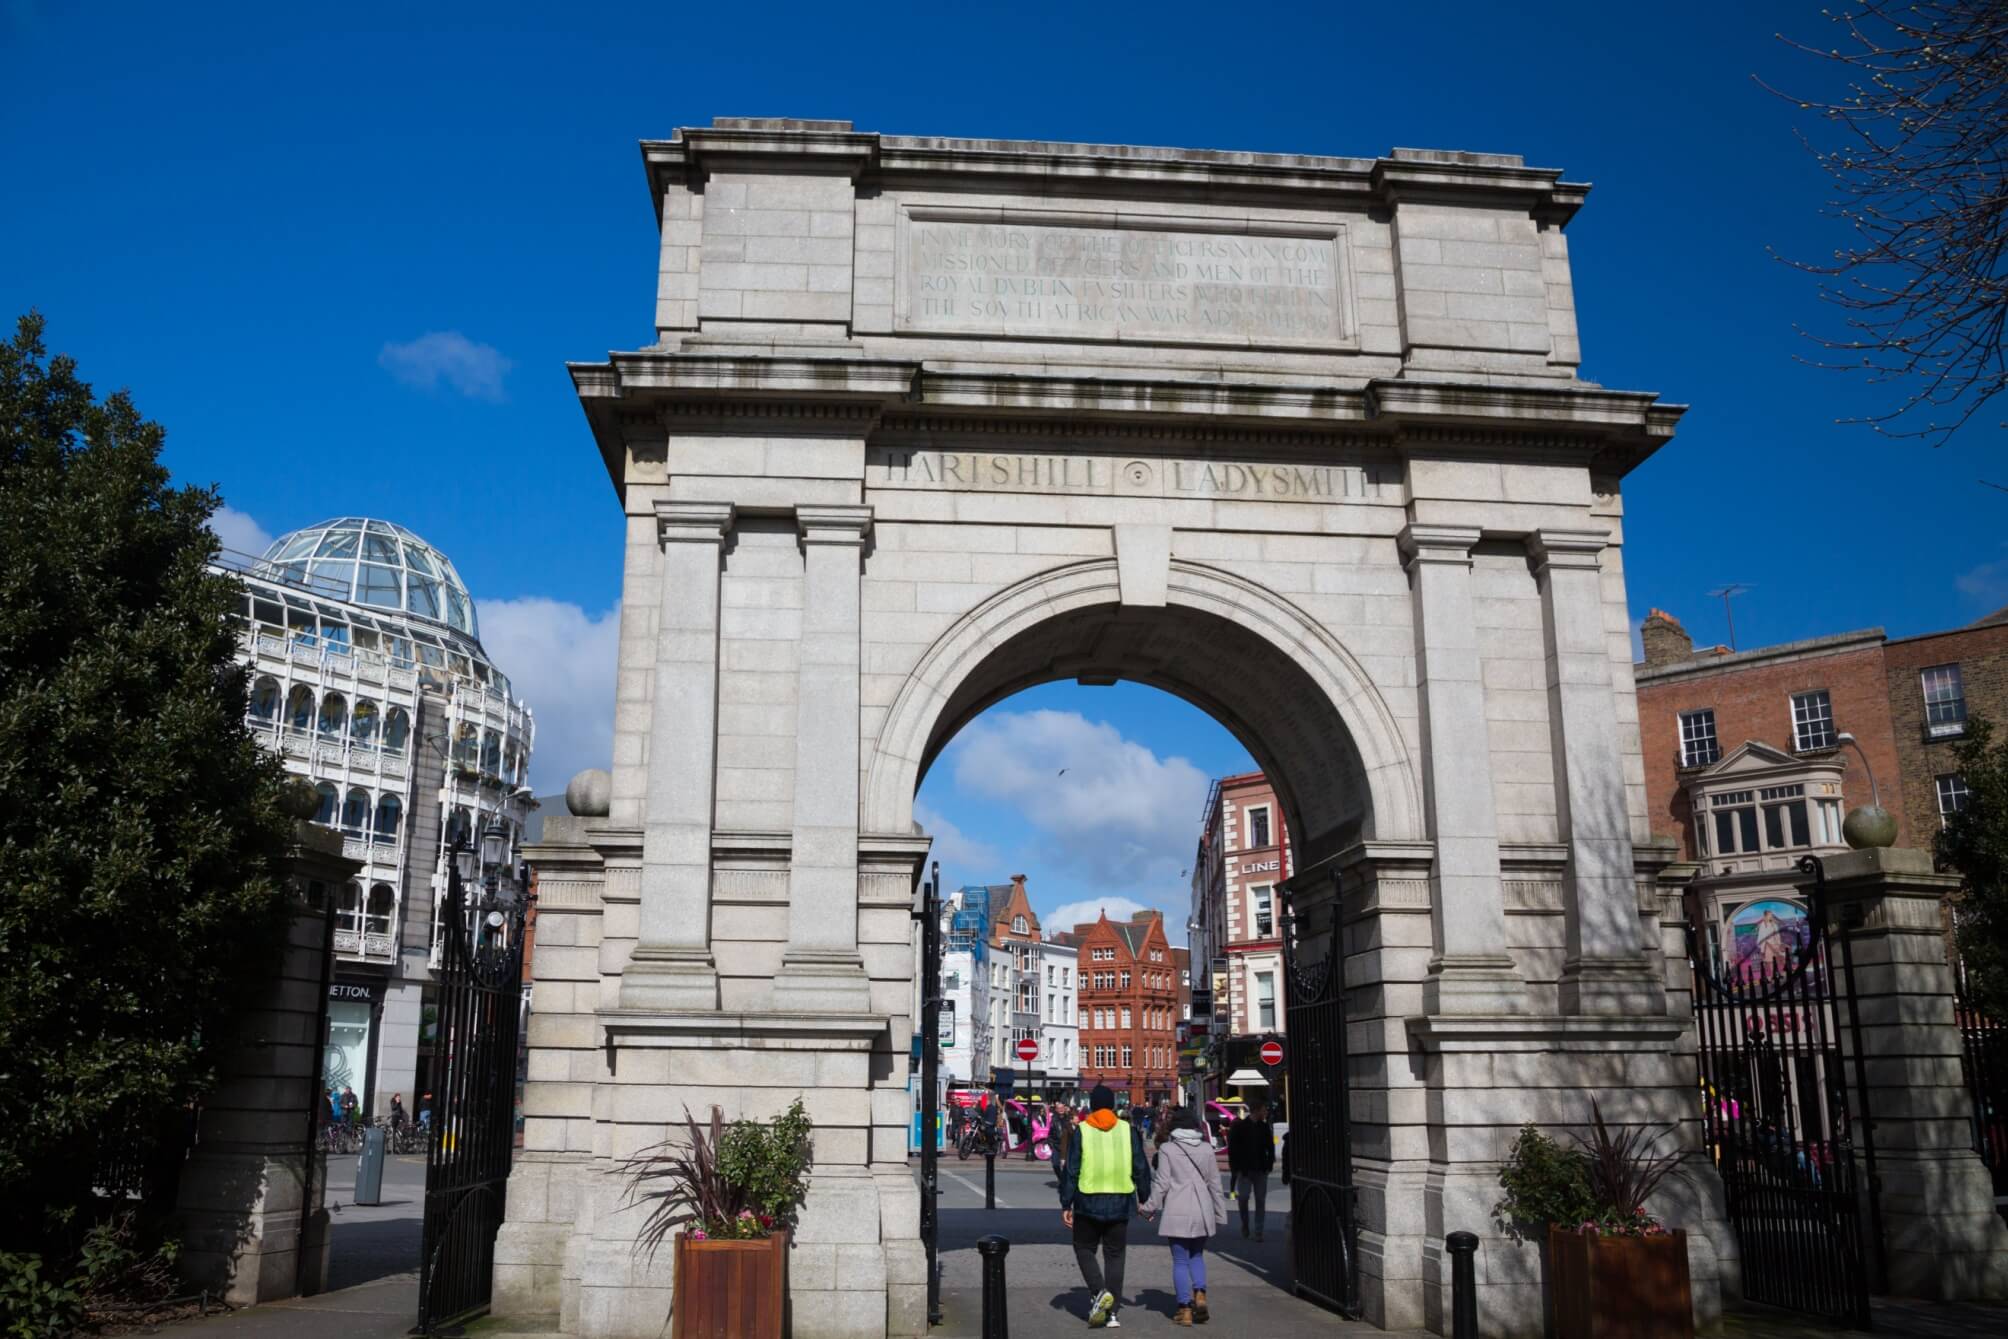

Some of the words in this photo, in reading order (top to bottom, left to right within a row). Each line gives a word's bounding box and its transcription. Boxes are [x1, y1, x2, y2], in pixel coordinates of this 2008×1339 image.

[920, 274, 990, 294] ROYAL
[1195, 263, 1243, 282] MEN
[1283, 268, 1325, 287] THE
[1144, 306, 1192, 325] WAR
[885, 452, 1107, 488] HARTSHILL
[1171, 461, 1382, 498] LADYSMITH
[1241, 860, 1280, 874] LINE
